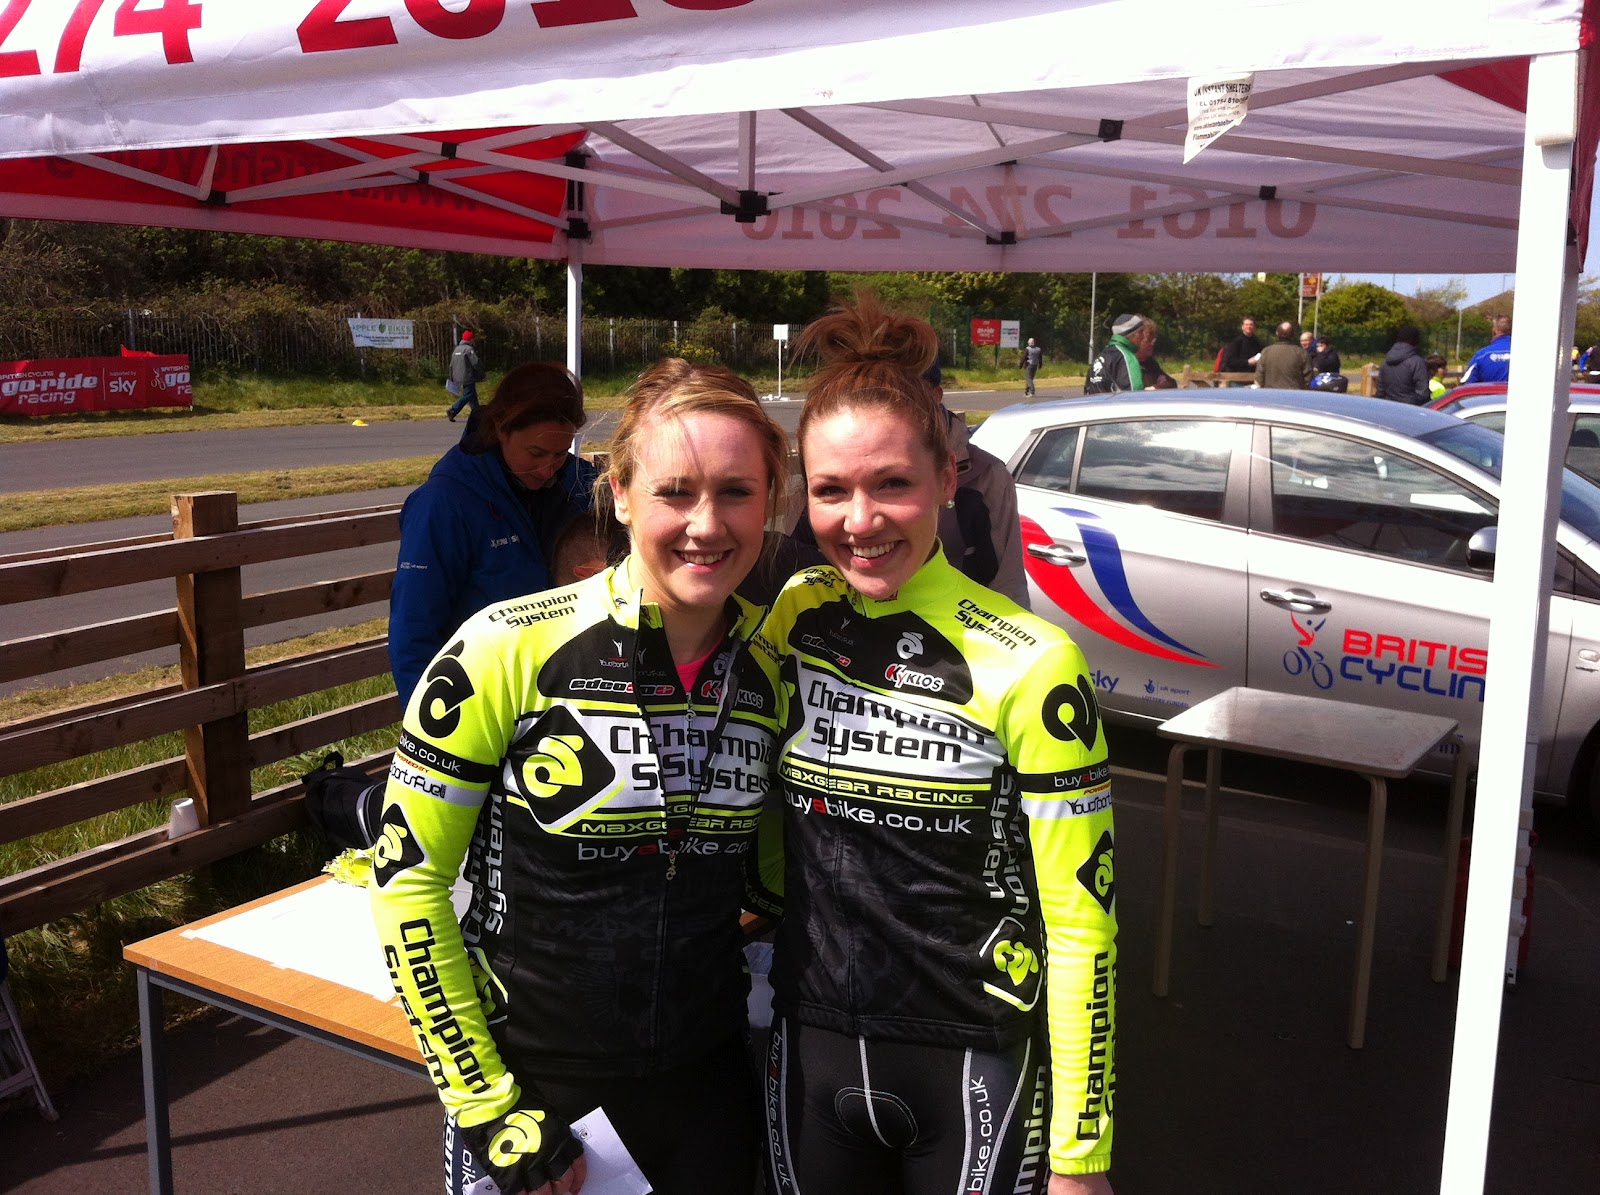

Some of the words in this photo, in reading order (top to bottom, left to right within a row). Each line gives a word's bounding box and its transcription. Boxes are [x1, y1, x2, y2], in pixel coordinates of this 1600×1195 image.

[1226, 83, 1251, 94] SHELTERS
[1, 372, 98, 397] go-ride
[18, 391, 76, 404] racing
[109, 377, 137, 396] sky
[488, 593, 578, 622] Champion
[505, 606, 575, 629] System
[954, 610, 1018, 650] System
[957, 599, 1037, 646] Champion
[1342, 629, 1488, 675] BRITIS
[807, 679, 986, 746] Champion
[1170, 688, 1190, 696] sport
[811, 717, 962, 763] System
[782, 764, 870, 795] MAXGEAR
[877, 785, 974, 804] RACING
[784, 785, 972, 835] buyabike.co.uk
[982, 774, 1016, 899] System
[485, 793, 507, 934] System
[400, 918, 491, 1094] Champion
[1076, 951, 1112, 1140] Champion
[769, 1031, 791, 1187] buyabike.co.uk
[966, 1076, 993, 1195] bike.co.uk
